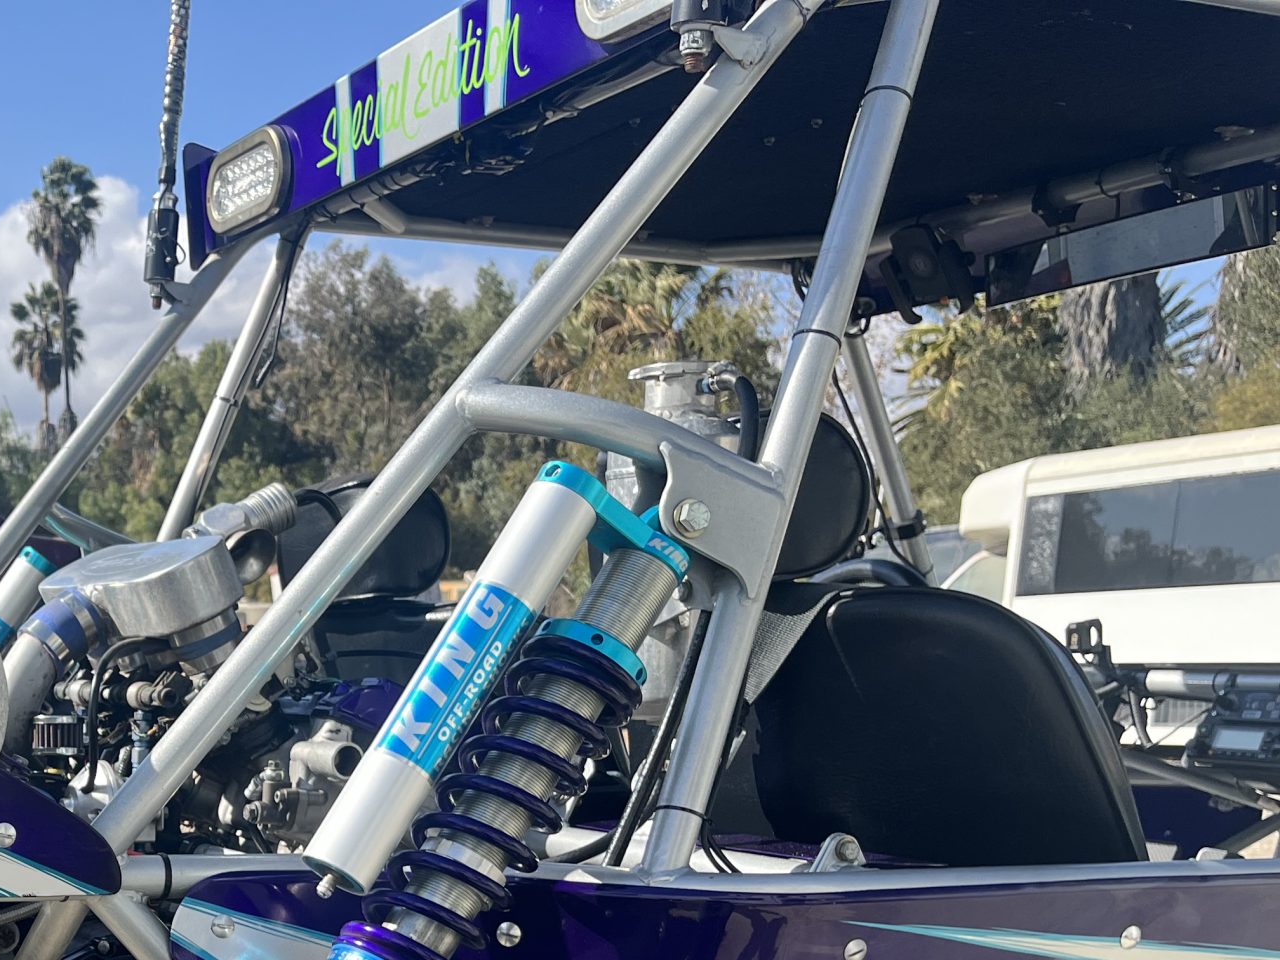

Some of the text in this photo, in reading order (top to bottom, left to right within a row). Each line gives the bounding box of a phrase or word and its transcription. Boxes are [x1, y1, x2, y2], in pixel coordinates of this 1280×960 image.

[316, 13, 530, 176] Special Edition
[647, 538, 688, 572] KING
[394, 591, 504, 752] KING
[437, 640, 502, 741] OFF-ROAD
